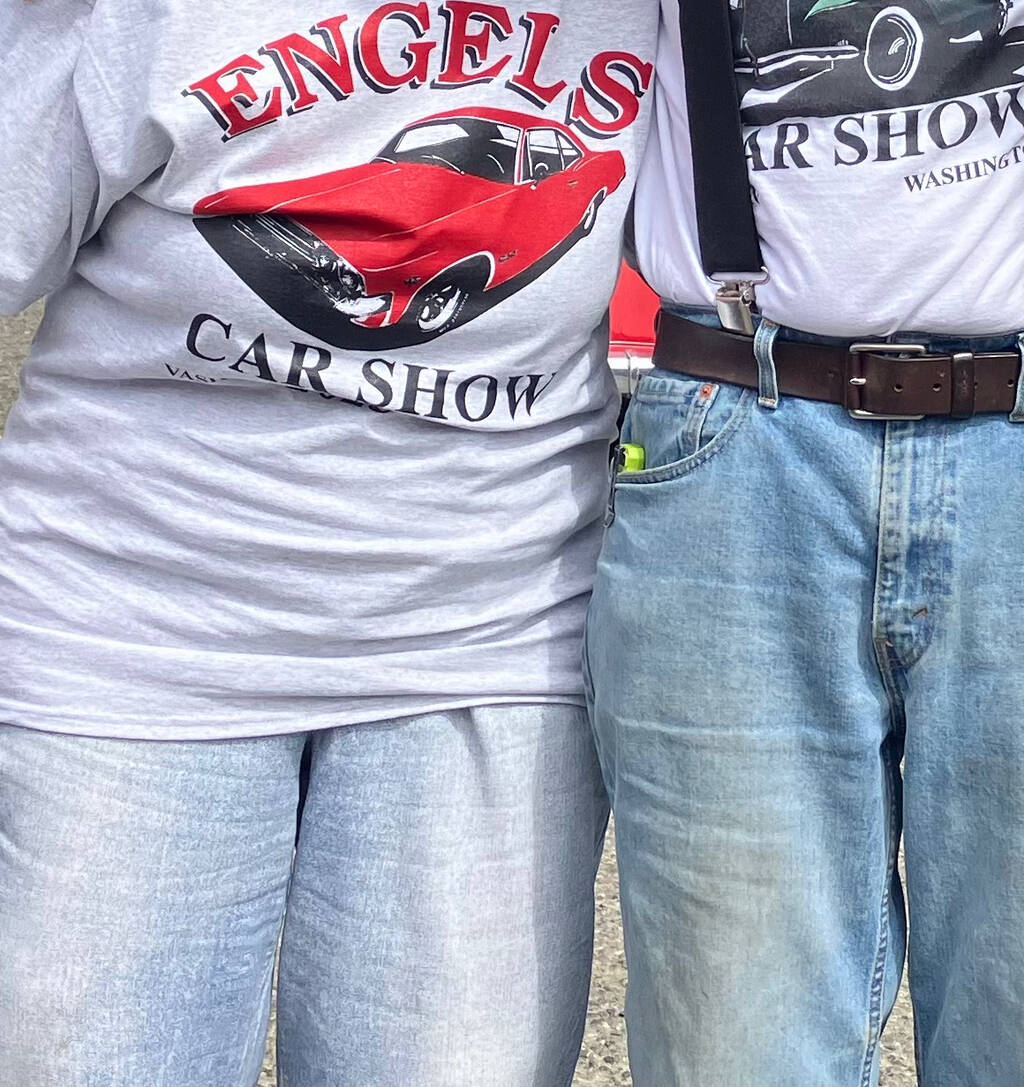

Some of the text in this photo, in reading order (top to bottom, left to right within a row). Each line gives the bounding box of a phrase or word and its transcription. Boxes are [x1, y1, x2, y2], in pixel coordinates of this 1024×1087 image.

[180, 0, 655, 142] ENGELS
[744, 122, 814, 172] AR
[186, 313, 333, 393] CAR
[356, 358, 556, 423] SHOW
